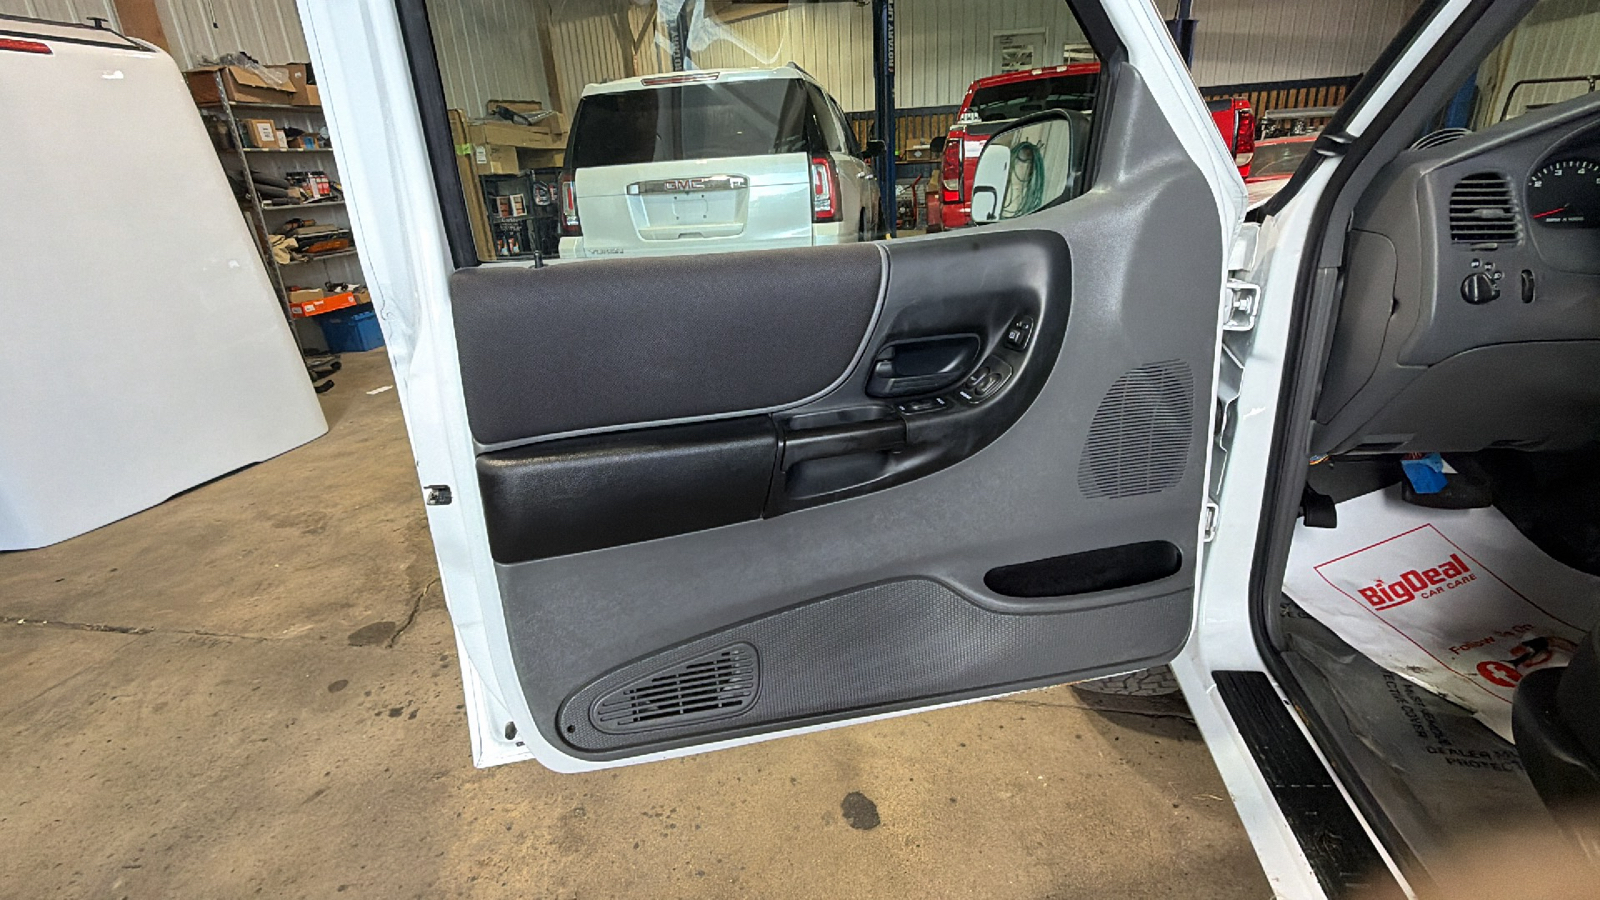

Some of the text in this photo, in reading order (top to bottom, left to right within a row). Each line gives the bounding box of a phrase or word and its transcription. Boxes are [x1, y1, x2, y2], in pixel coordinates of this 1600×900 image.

[665, 179, 705, 190] GMC
[1357, 553, 1470, 611] BigDeal
[1421, 573, 1477, 599] CAR CARE
[1448, 636, 1495, 655] Follow
[1401, 704, 1428, 739] COVER
